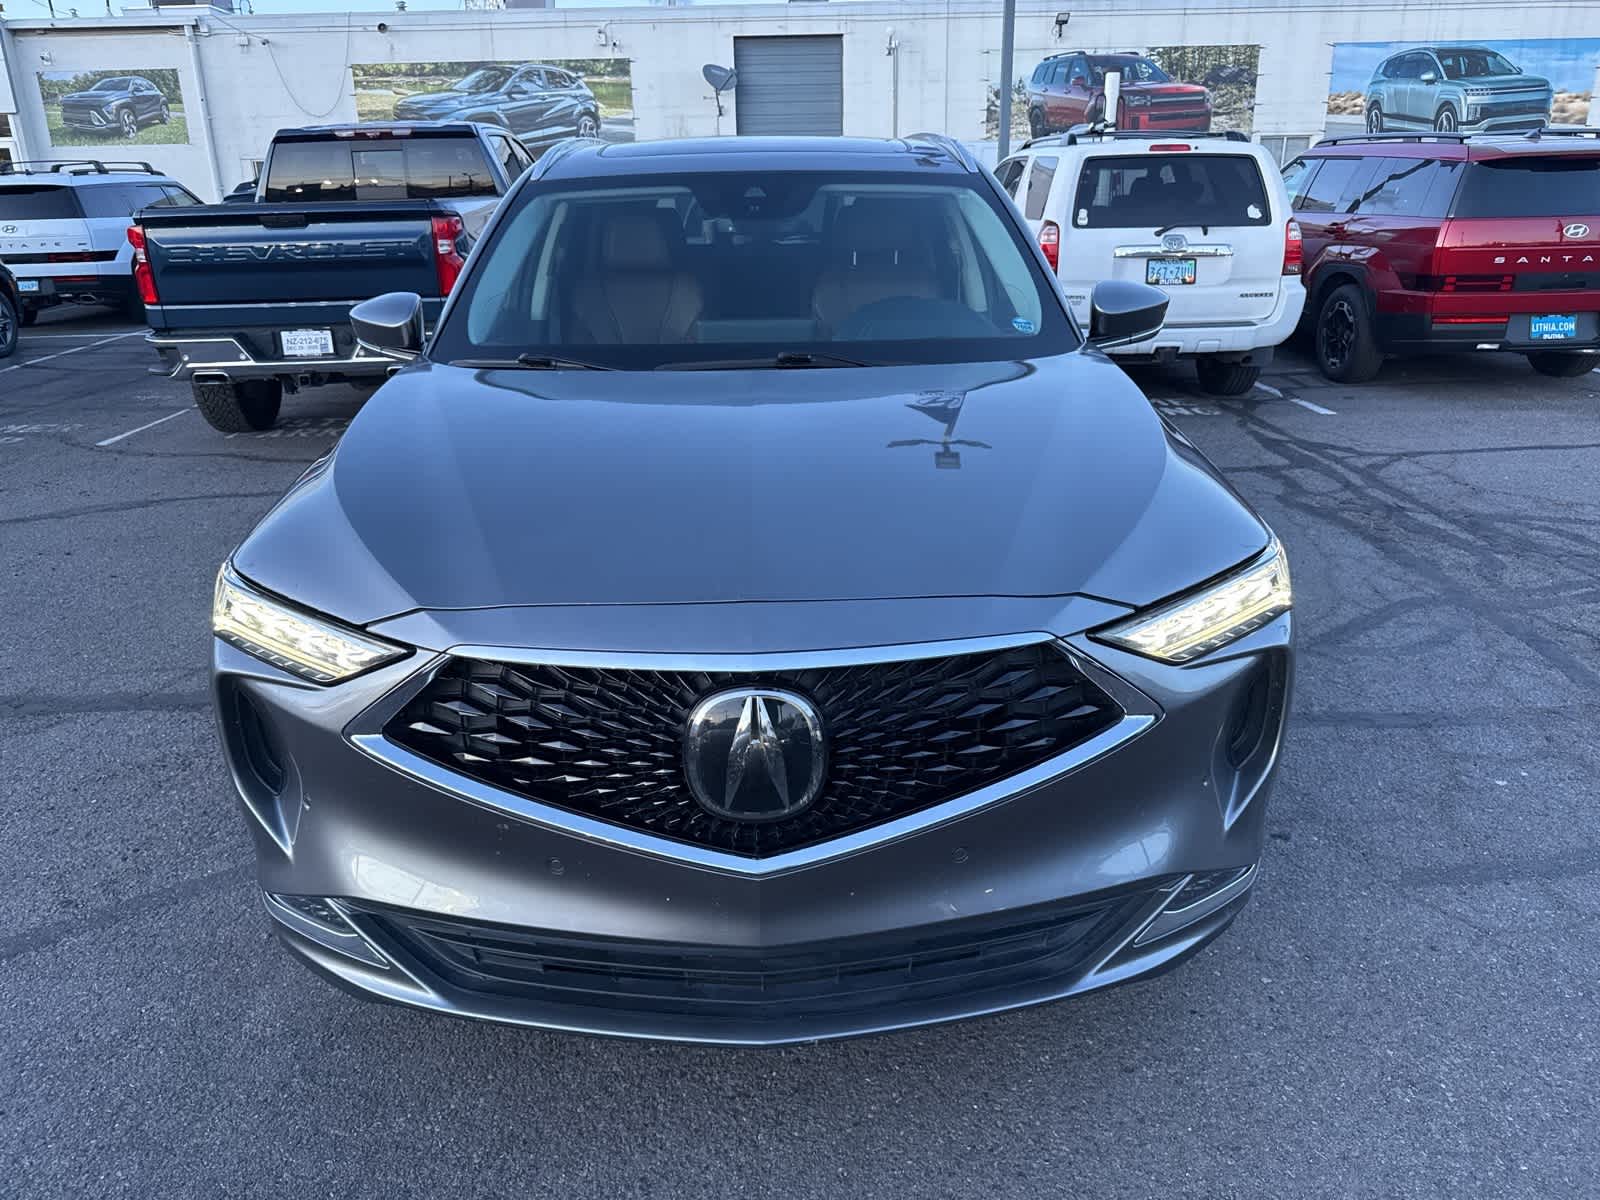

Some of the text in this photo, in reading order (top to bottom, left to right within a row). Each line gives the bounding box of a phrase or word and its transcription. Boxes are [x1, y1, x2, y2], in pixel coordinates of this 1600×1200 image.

[168, 241, 413, 262] CHEVROLET
[1493, 255, 1594, 263] SANTA
[1531, 322, 1575, 332] LITHIA.COM
